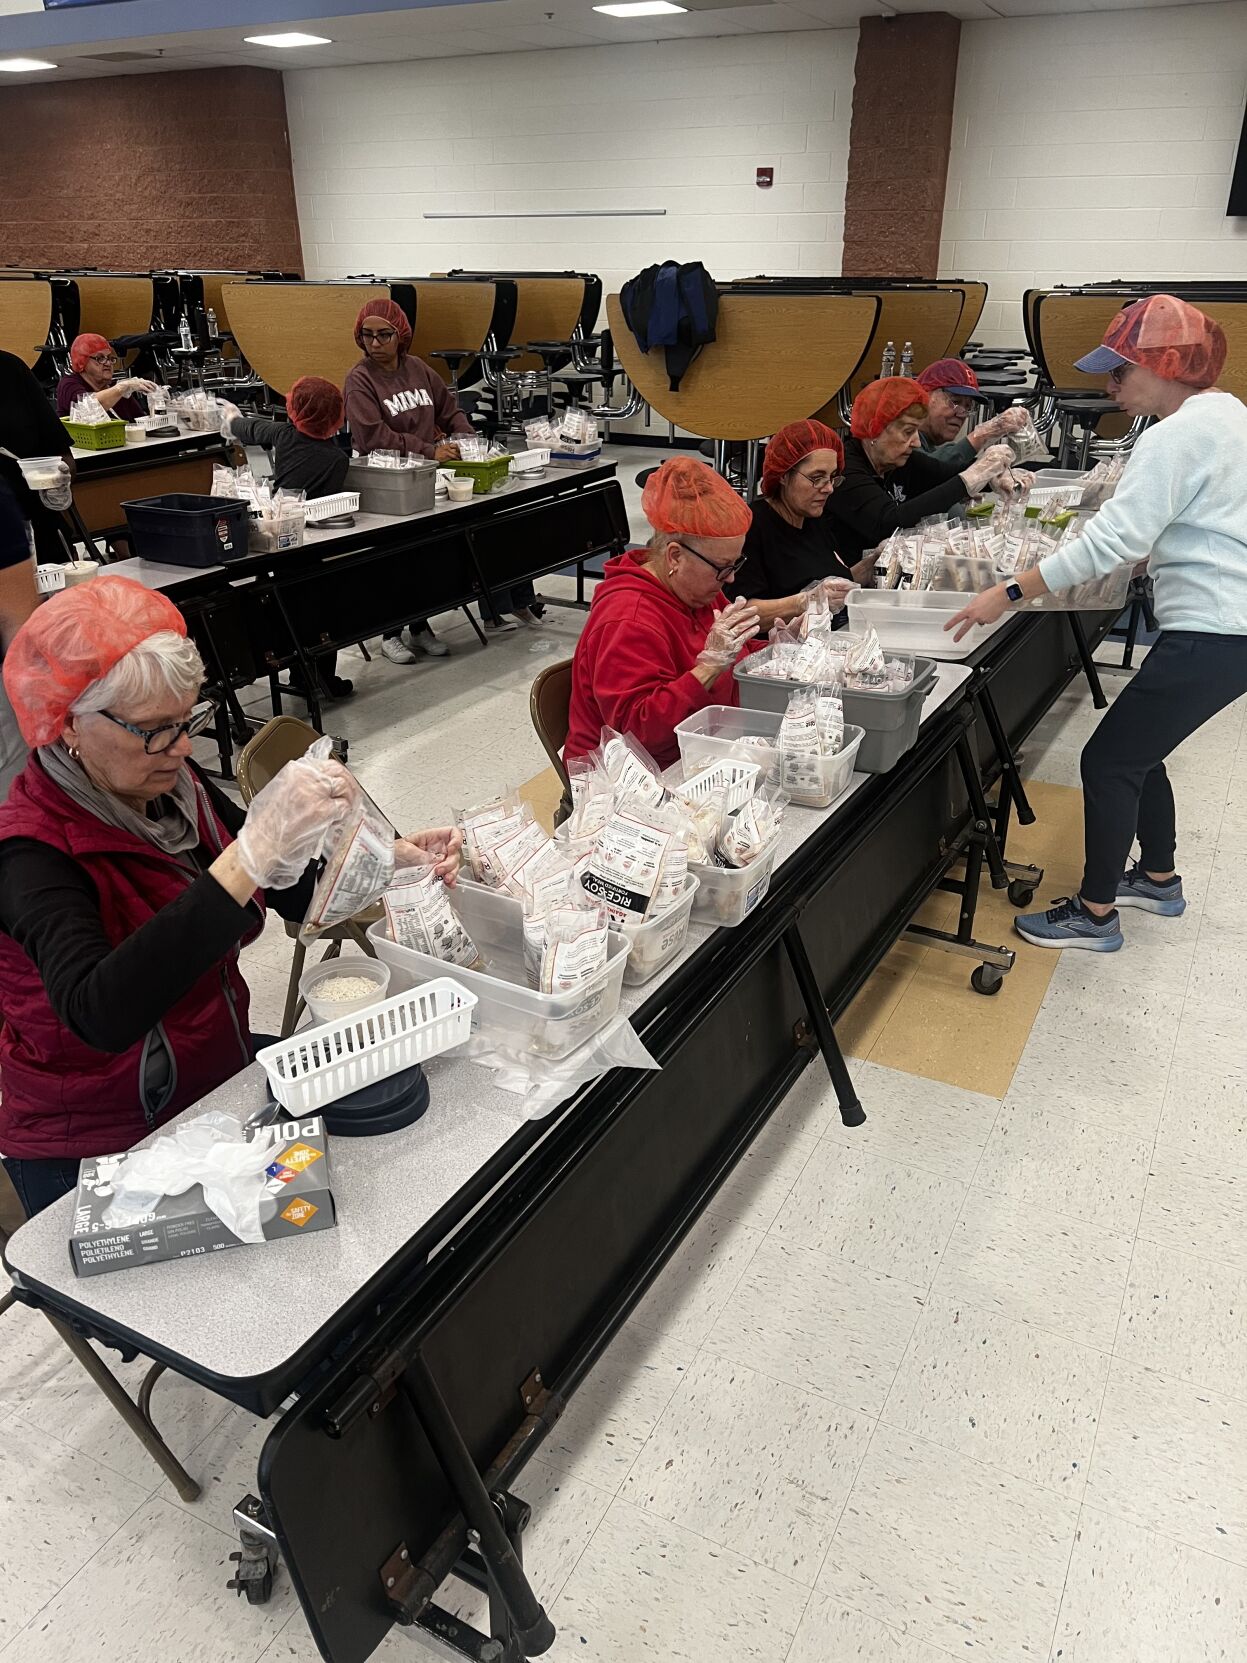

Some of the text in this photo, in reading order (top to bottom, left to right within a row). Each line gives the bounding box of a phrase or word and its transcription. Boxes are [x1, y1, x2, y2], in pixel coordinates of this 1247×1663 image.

[383, 388, 433, 417] MIMA
[74, 1205, 92, 1235] LARGE
[139, 1229, 155, 1238] LARGE
[79, 1234, 131, 1250] POLYETHYLENE
[80, 1244, 125, 1257] POLIETILENO
[180, 1246, 206, 1257] P2103
